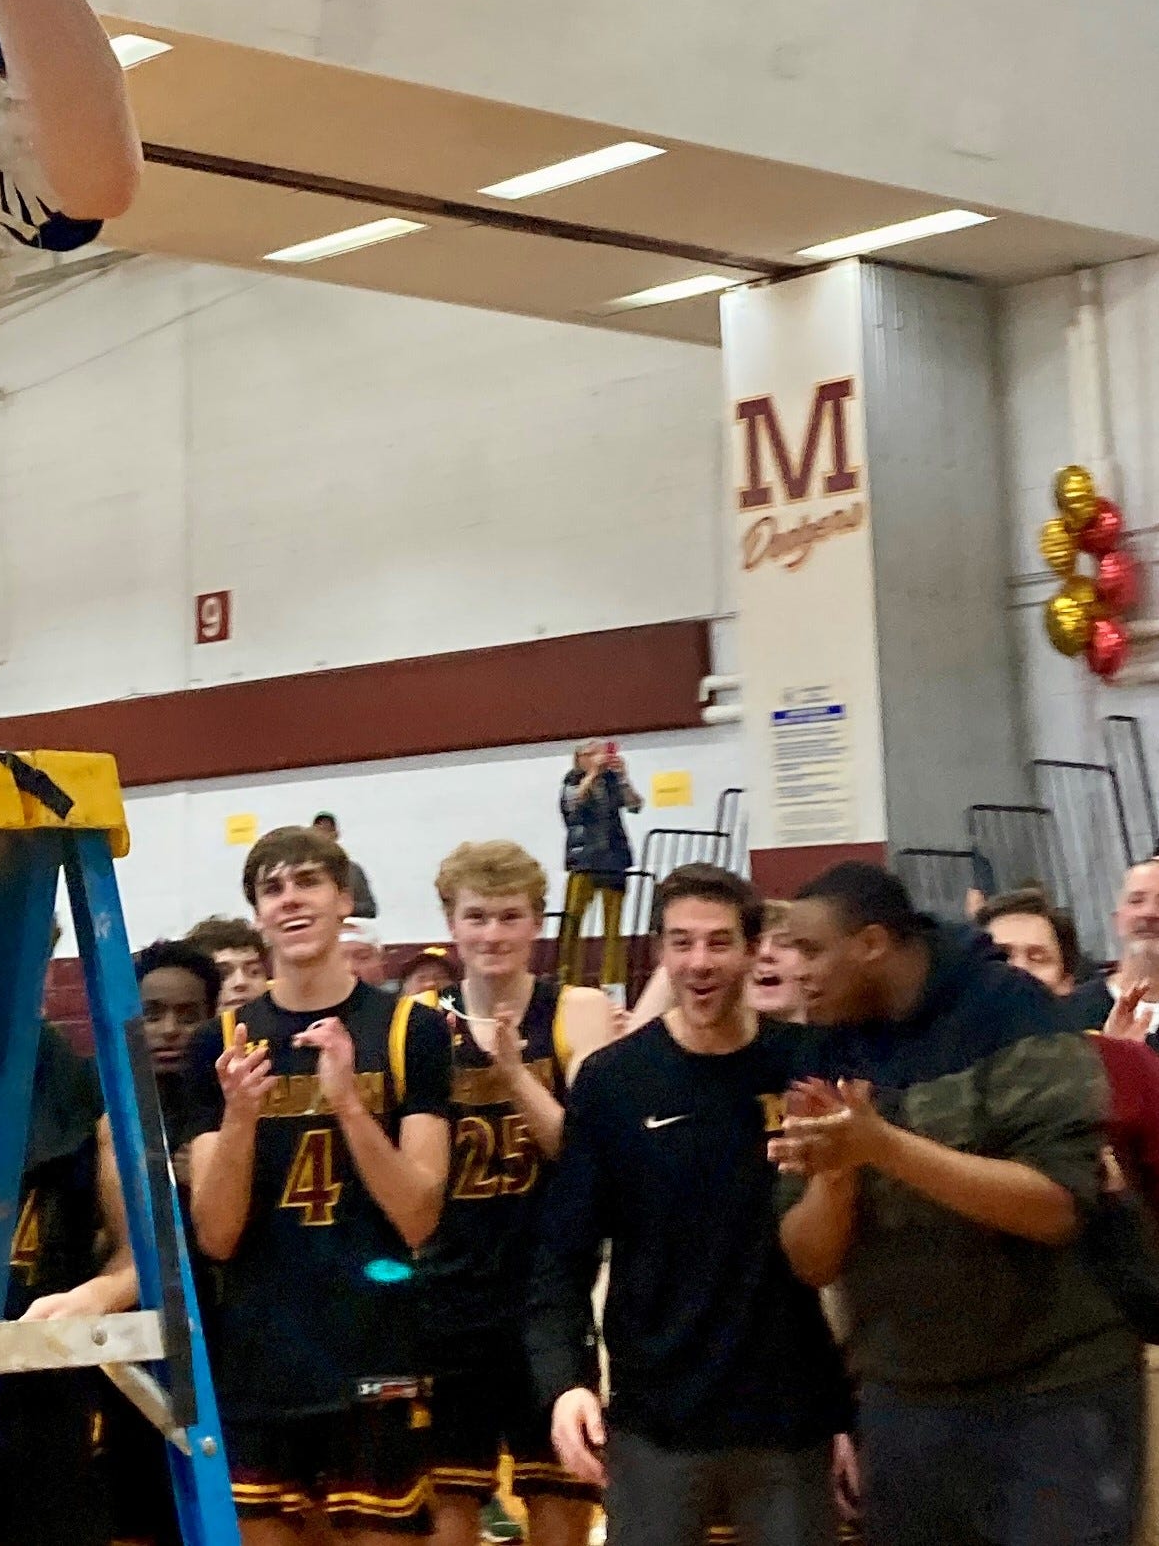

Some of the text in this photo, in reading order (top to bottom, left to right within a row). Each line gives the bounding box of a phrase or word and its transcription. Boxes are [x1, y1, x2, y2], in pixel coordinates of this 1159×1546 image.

[736, 375, 863, 513] M
[201, 596, 222, 638] 9
[278, 1128, 343, 1227] 4
[451, 1115, 539, 1200] 25
